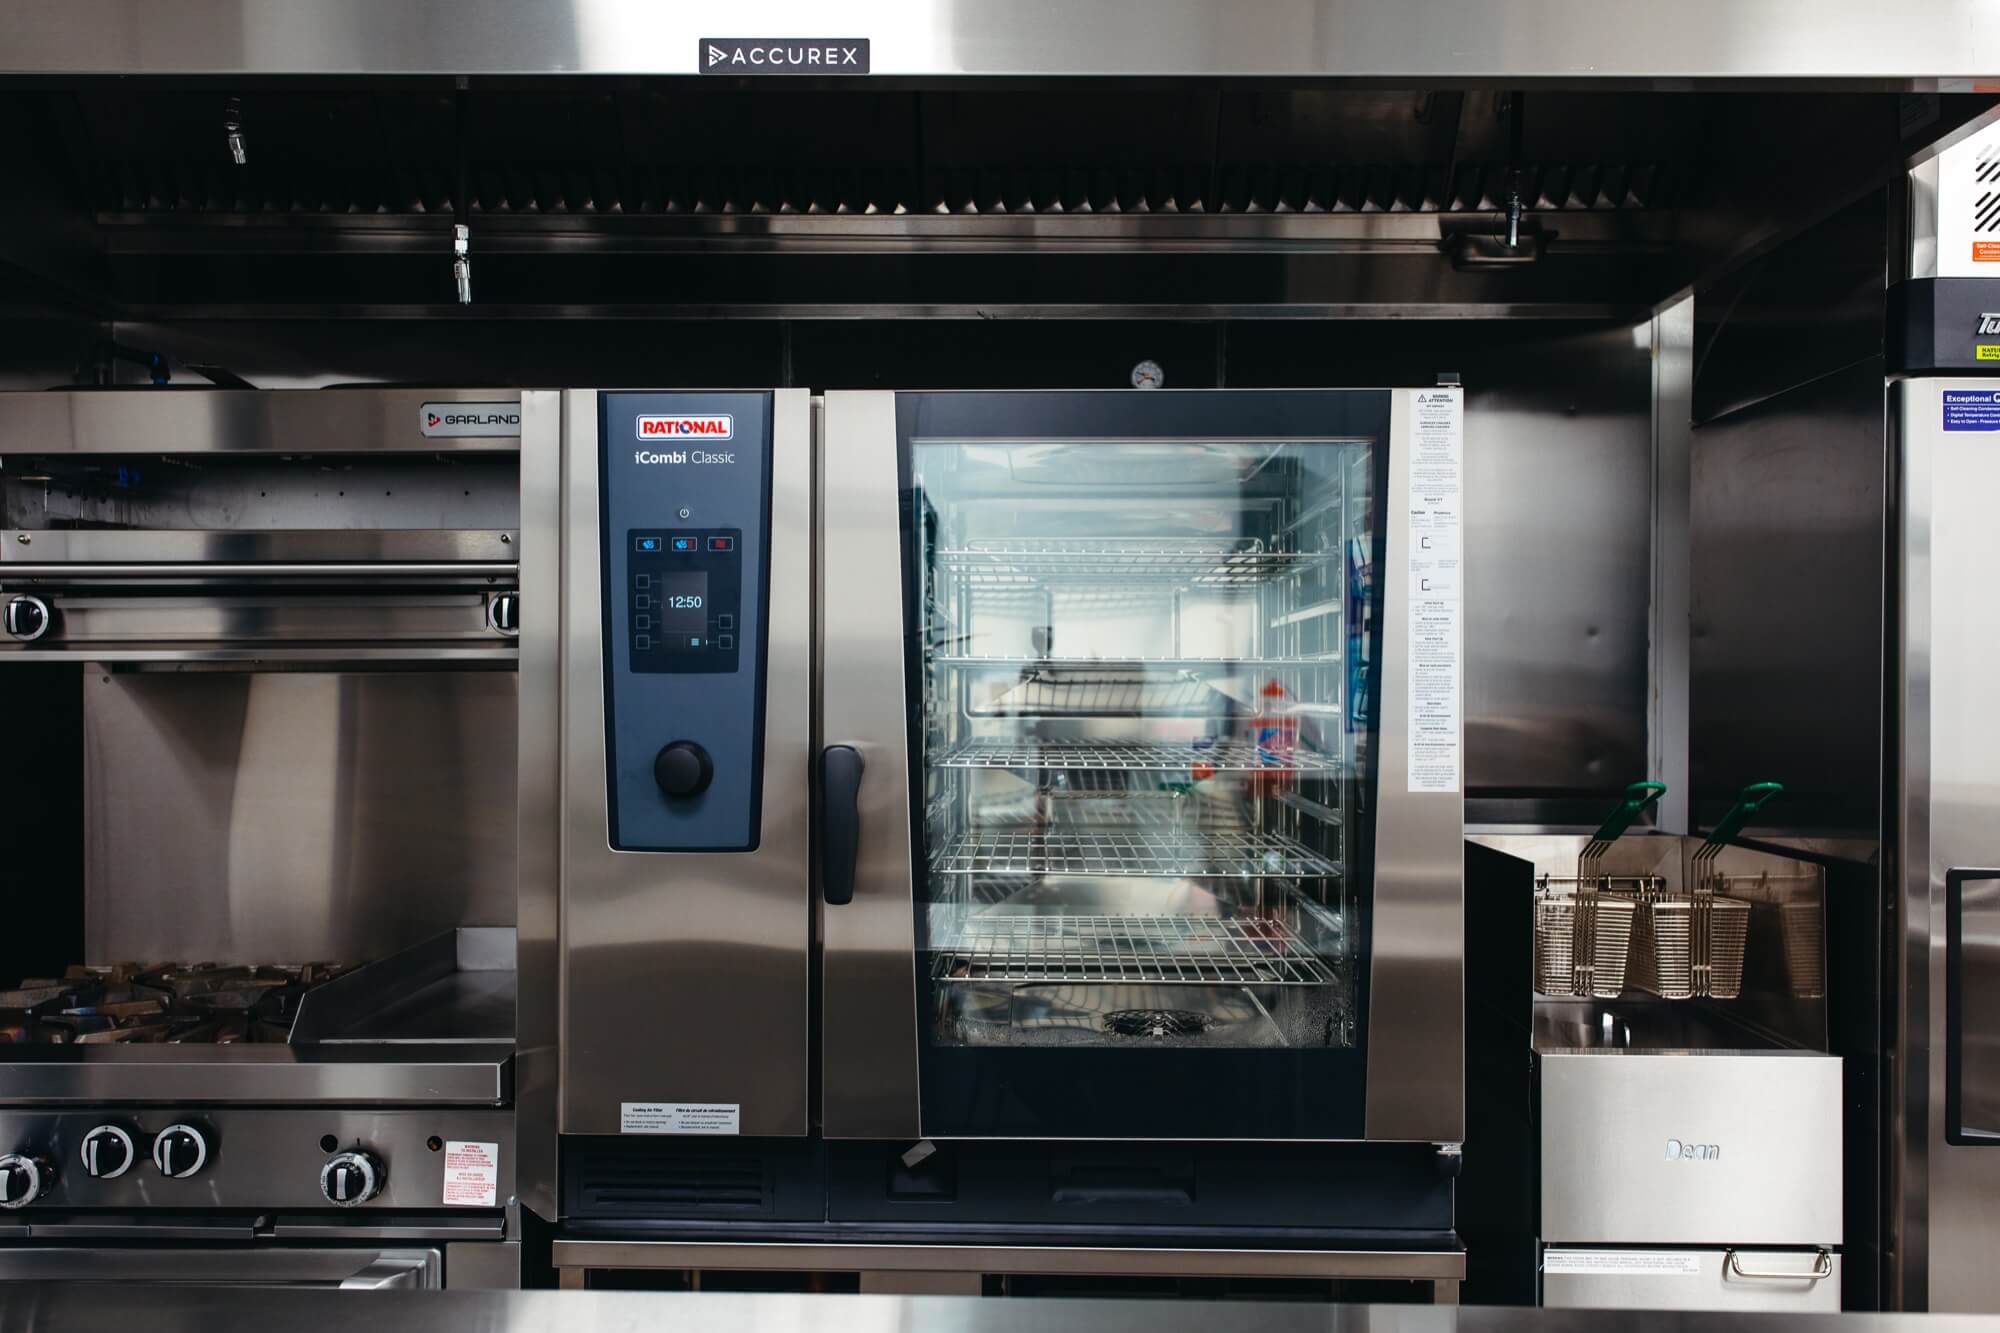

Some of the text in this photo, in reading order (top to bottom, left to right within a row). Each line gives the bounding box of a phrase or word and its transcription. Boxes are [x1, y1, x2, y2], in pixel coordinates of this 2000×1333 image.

[731, 47, 857, 65] ACCUREX
[1946, 394, 1991, 403] Exceptional
[445, 415, 520, 425] GARLAND
[643, 421, 728, 434] RATIONAL
[635, 451, 736, 464] iCombi Classic
[669, 596, 702, 608] 12:50
[1664, 1138, 1720, 1161] Dean
